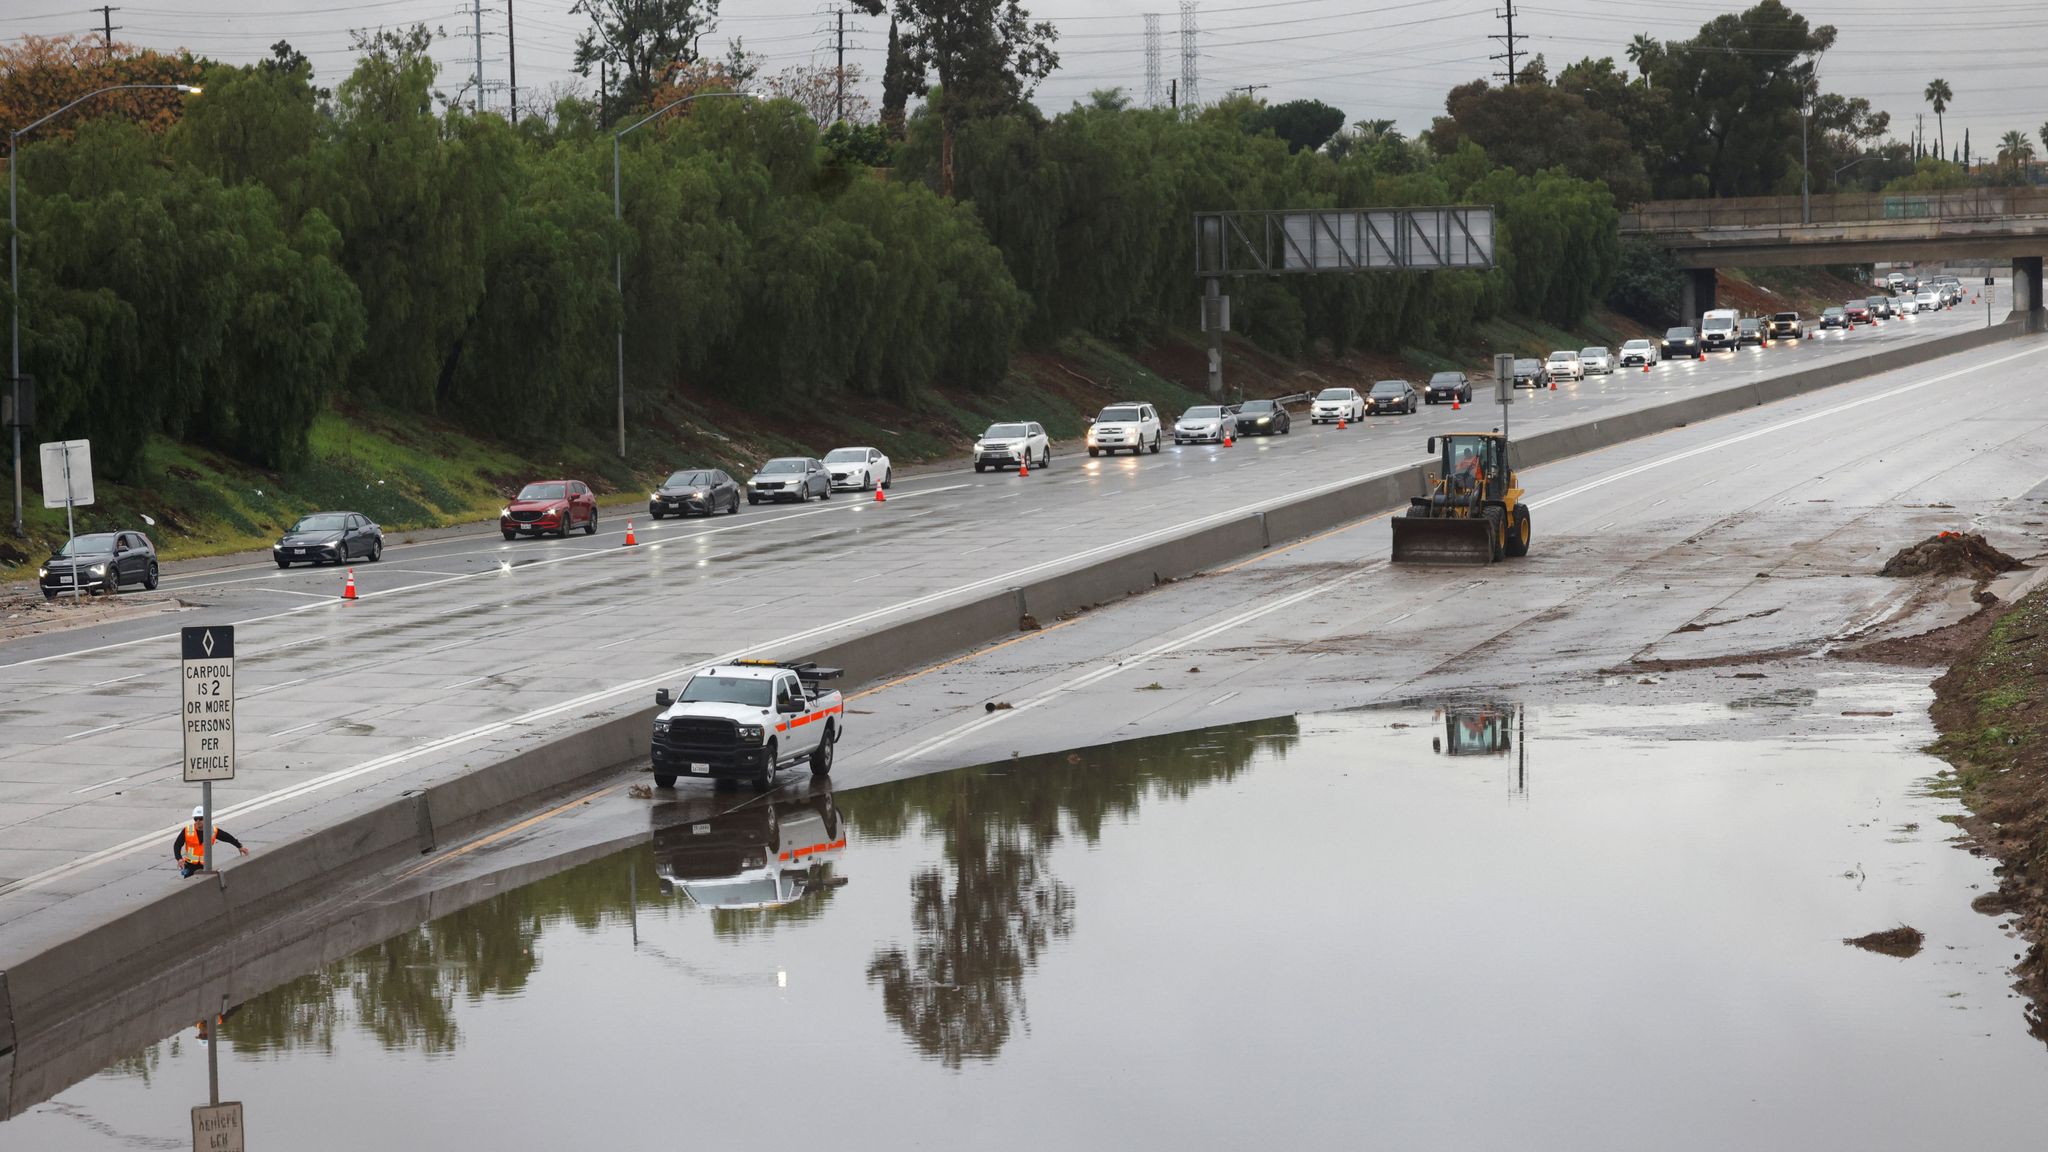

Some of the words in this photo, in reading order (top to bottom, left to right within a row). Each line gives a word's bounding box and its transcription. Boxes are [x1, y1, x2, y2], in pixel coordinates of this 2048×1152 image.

[186, 664, 231, 679] CARPOOL
[198, 682, 208, 696] IS
[211, 679, 220, 696] 2
[187, 701, 201, 714] OR
[205, 699, 230, 713] MORE
[187, 718, 231, 733] PERSONS
[201, 738, 219, 751] PER
[190, 755, 229, 770] VEHICLE
